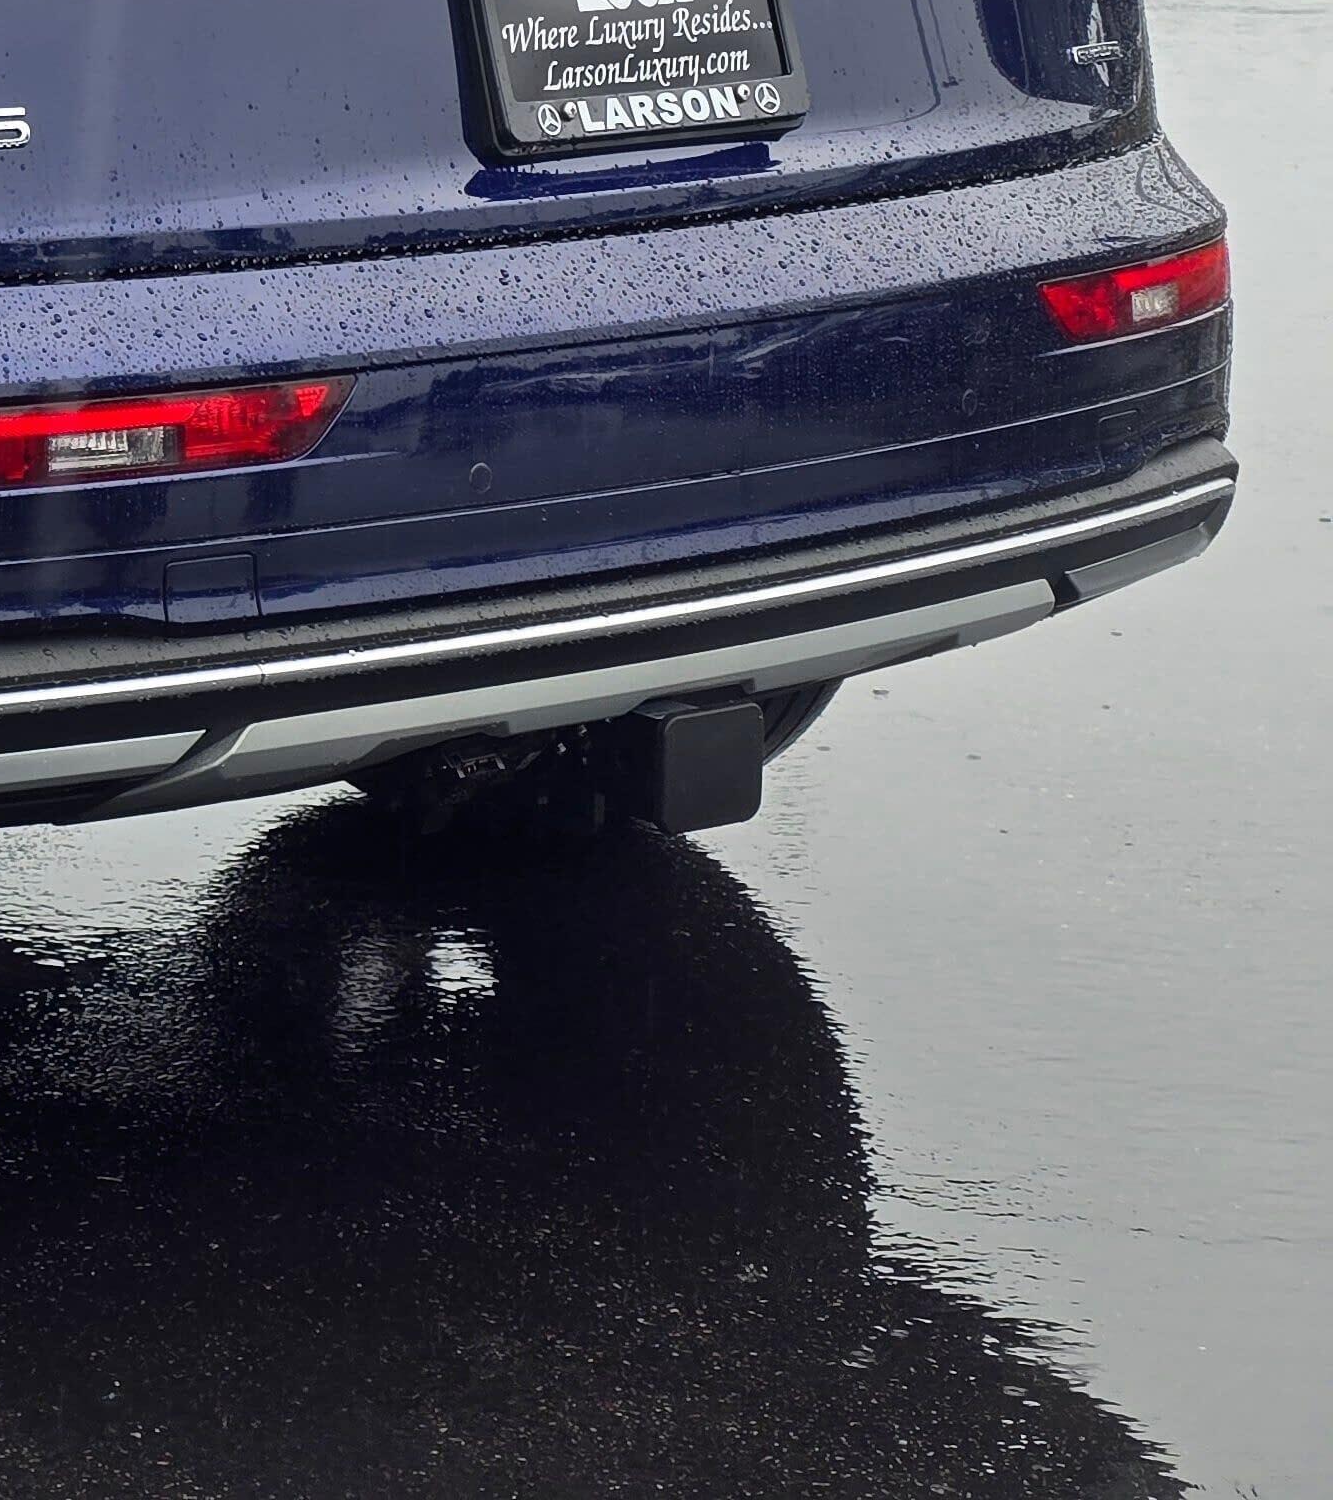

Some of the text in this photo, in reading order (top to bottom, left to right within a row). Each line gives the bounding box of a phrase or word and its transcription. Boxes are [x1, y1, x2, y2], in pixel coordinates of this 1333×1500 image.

[502, 0, 773, 54] Where Luxury Resides...
[543, 49, 750, 91] LarsonLuxury.com
[577, 86, 741, 131] LARSON
